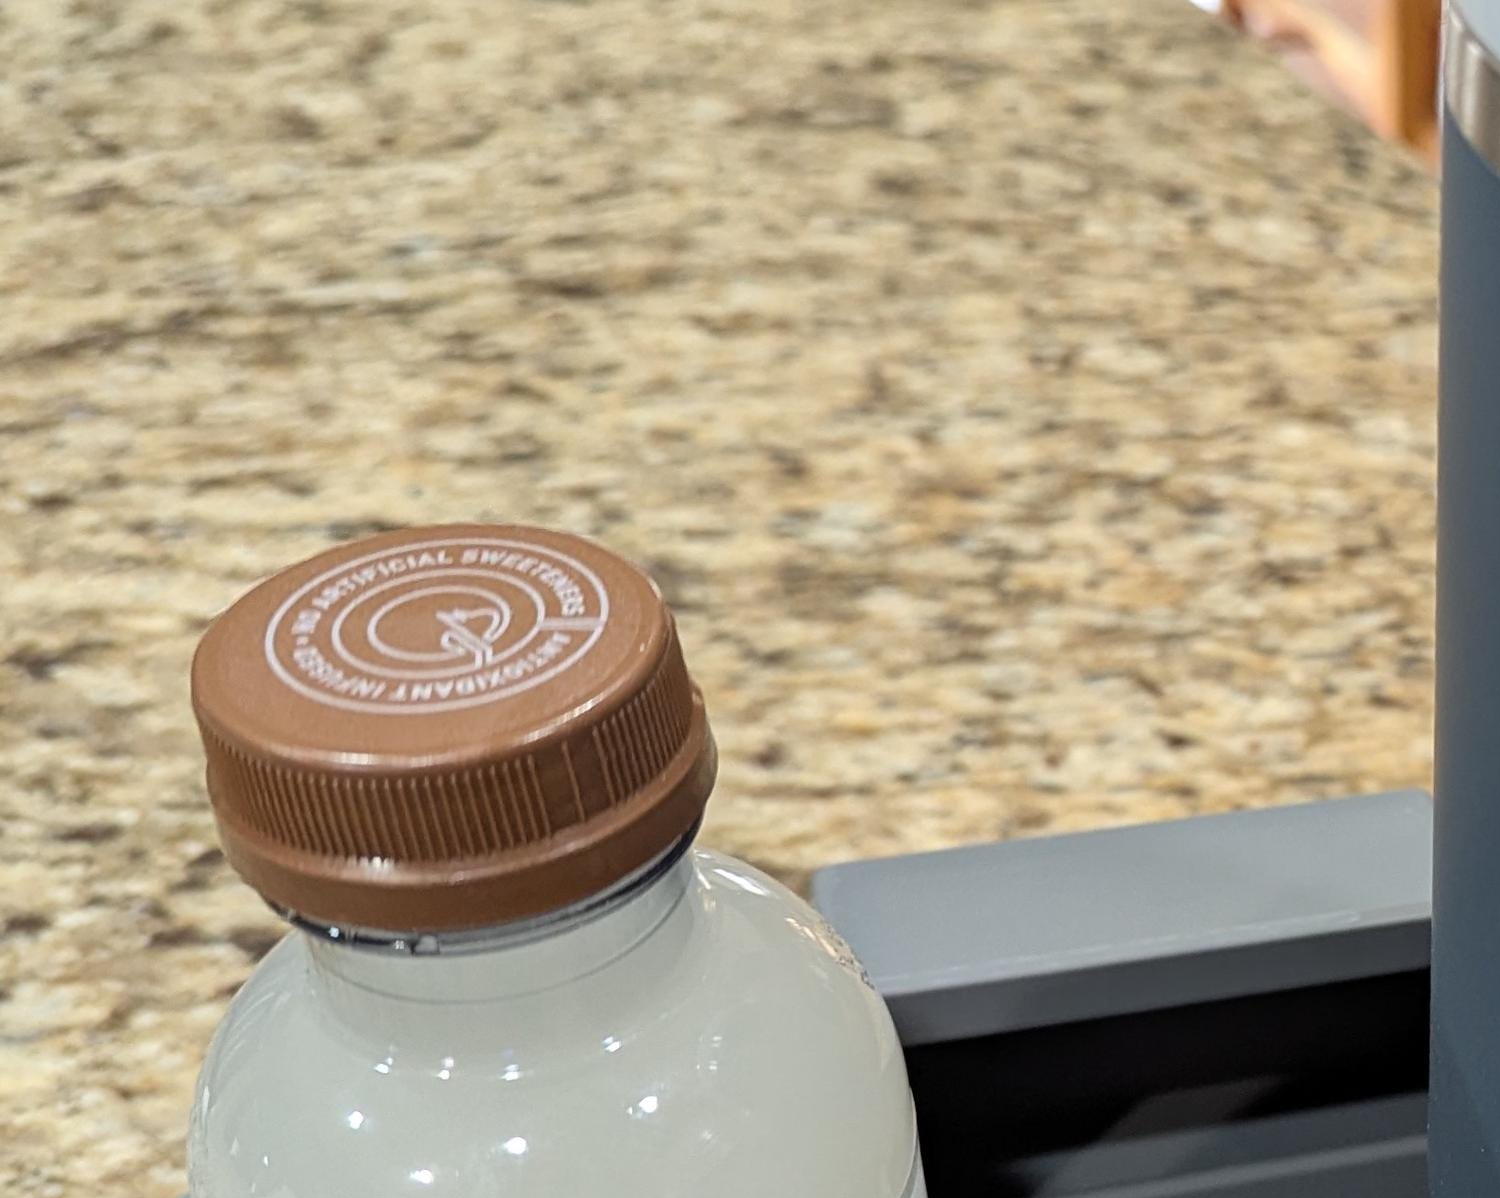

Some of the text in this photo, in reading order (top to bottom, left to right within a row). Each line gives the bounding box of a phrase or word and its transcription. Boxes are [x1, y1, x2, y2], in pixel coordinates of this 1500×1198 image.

[291, 548, 586, 636] NO ARTIFICIAL SWEETENERS
[293, 631, 571, 701] ANTIOXIDANT INFUSED
